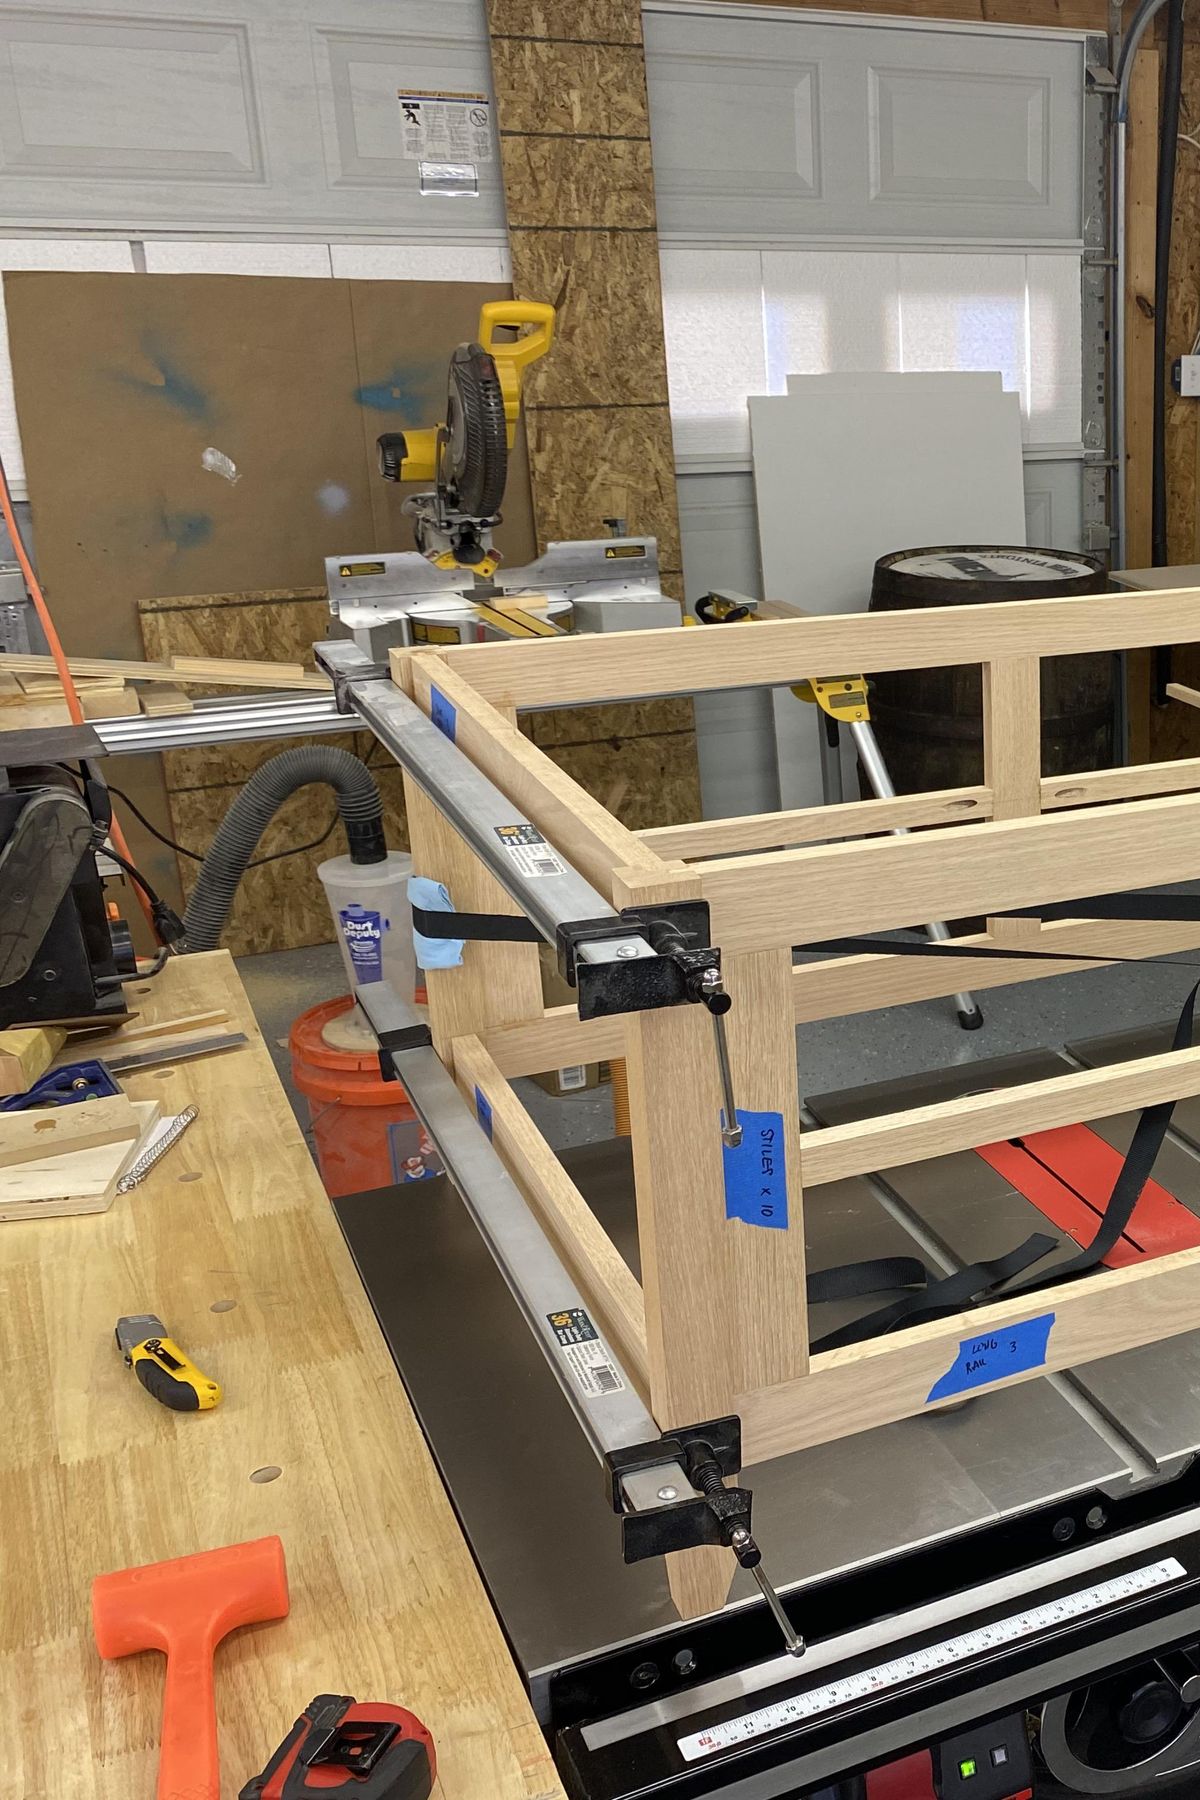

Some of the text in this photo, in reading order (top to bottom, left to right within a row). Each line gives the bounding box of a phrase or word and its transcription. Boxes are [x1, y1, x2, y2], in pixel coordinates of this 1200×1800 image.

[978, 554, 1047, 568] VIRGINIA
[346, 920, 373, 932] Dust
[343, 927, 380, 939] Deputy
[760, 1128, 775, 1176] STILES
[760, 1204, 774, 1217] 10
[1009, 1340, 1017, 1353] 3
[743, 1721, 754, 1729] 11
[785, 1705, 796, 1714] 10
